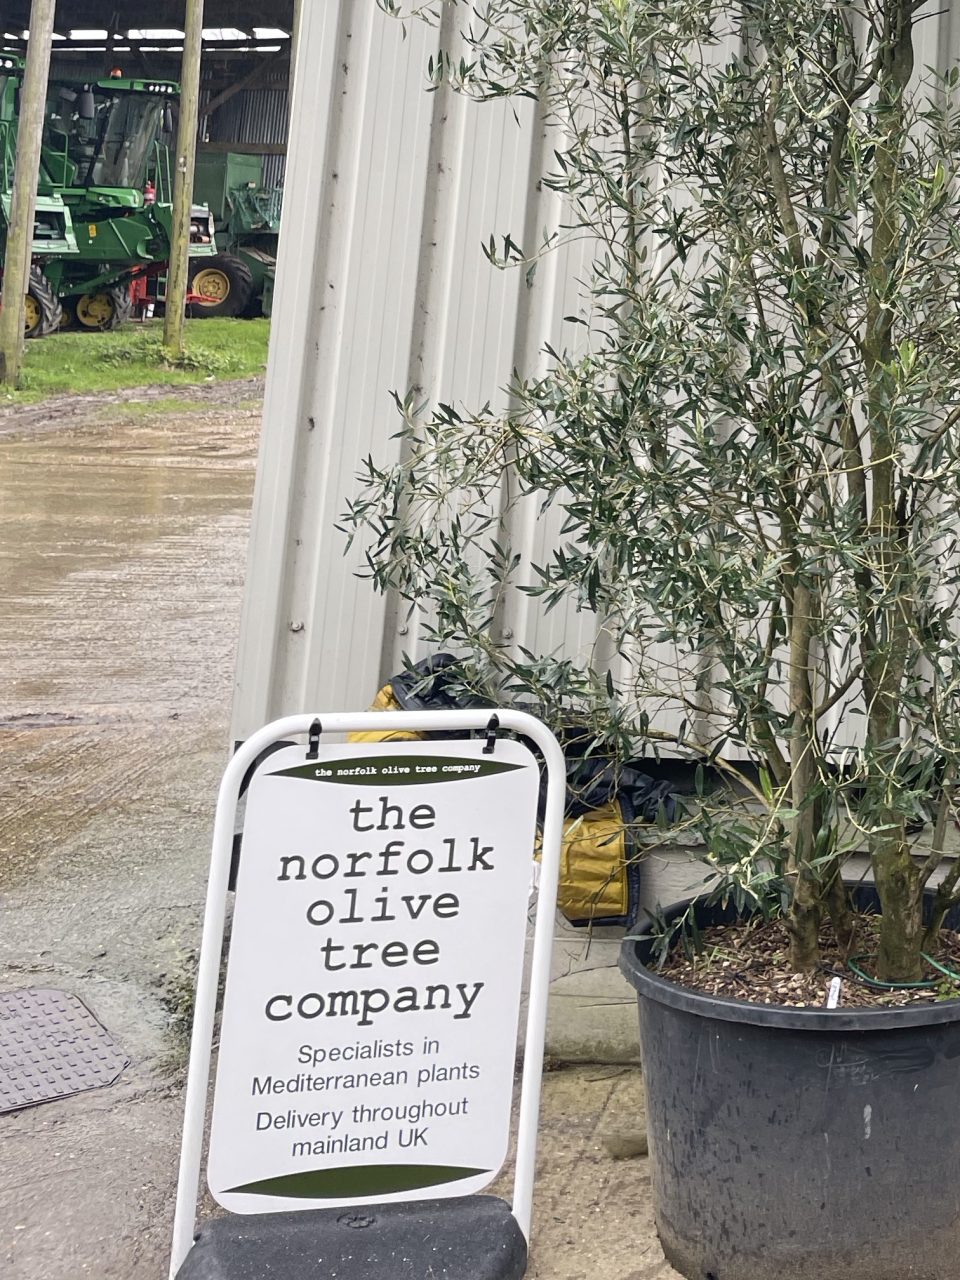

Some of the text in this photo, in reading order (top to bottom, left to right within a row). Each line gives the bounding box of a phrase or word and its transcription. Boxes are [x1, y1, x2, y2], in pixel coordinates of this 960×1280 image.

[315, 763, 481, 777] the norfolk olive tree company
[349, 796, 436, 832] the
[277, 837, 495, 881] norfolk
[306, 887, 460, 926] olive
[320, 937, 440, 972] tree
[265, 982, 485, 1027] company
[297, 1036, 440, 1067] Specialists in
[251, 1062, 480, 1096] Mediterranean plants
[256, 1097, 469, 1131] Delivery throughout
[292, 1127, 428, 1156] mainland UK
